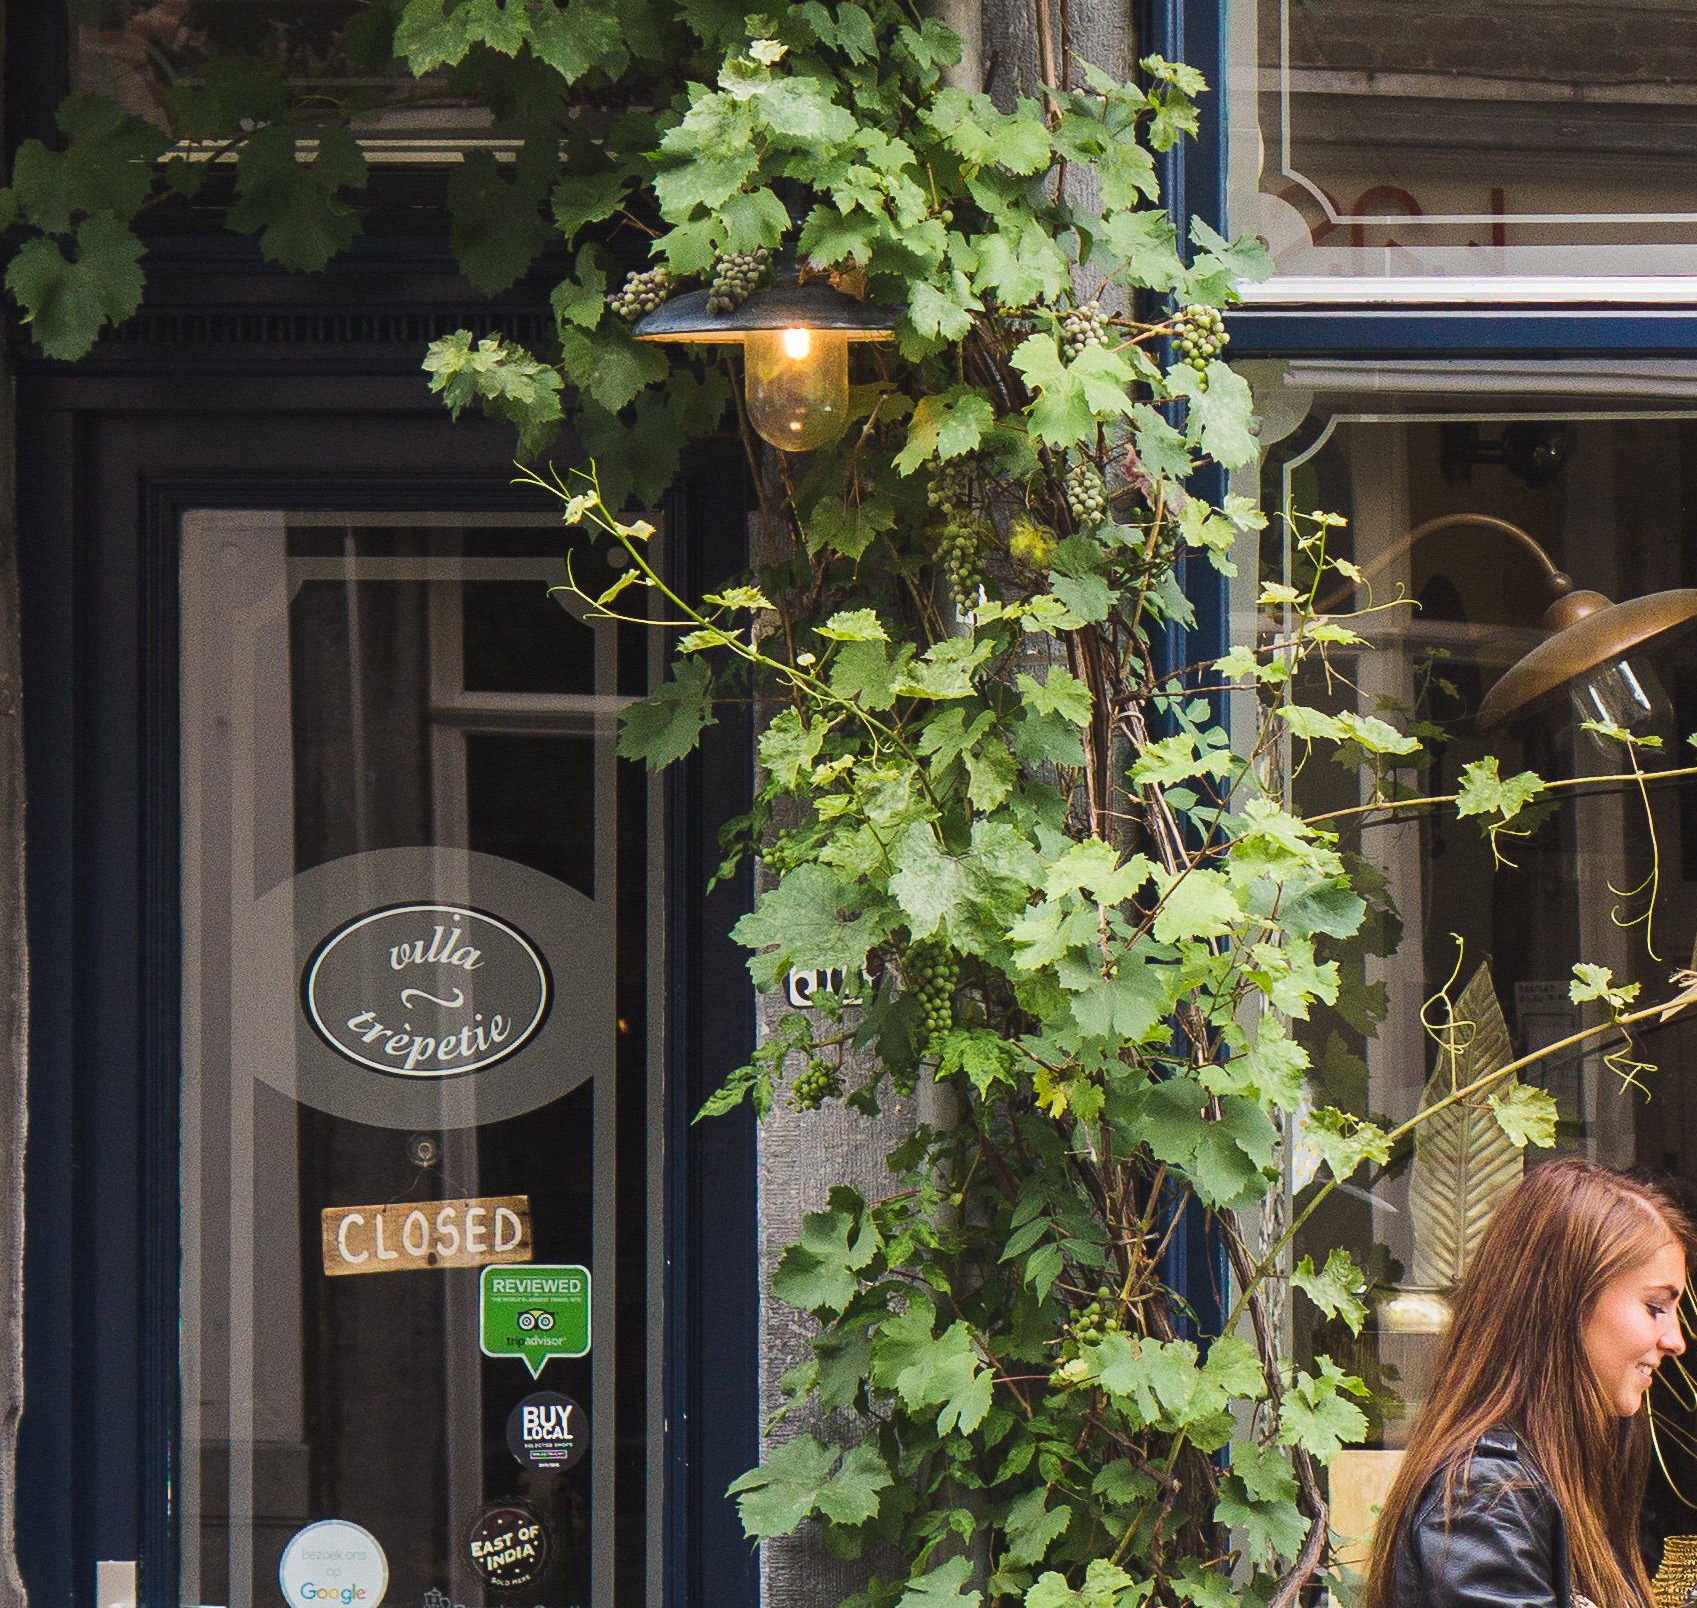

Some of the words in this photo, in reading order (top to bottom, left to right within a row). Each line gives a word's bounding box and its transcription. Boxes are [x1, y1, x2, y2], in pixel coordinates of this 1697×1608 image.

[389, 913, 485, 971] villa
[347, 1009, 511, 1070] trèpetie
[337, 1206, 523, 1264] CLOSED
[492, 1278, 581, 1294] REVIEWED
[506, 1335, 564, 1348] tripadvisor
[523, 1405, 573, 1428] BUY
[523, 1426, 574, 1441] LOCAL
[471, 1533, 513, 1557] EAST
[518, 1525, 539, 1541] OF
[487, 1543, 535, 1571] INDIA
[300, 1582, 366, 1605] Google
